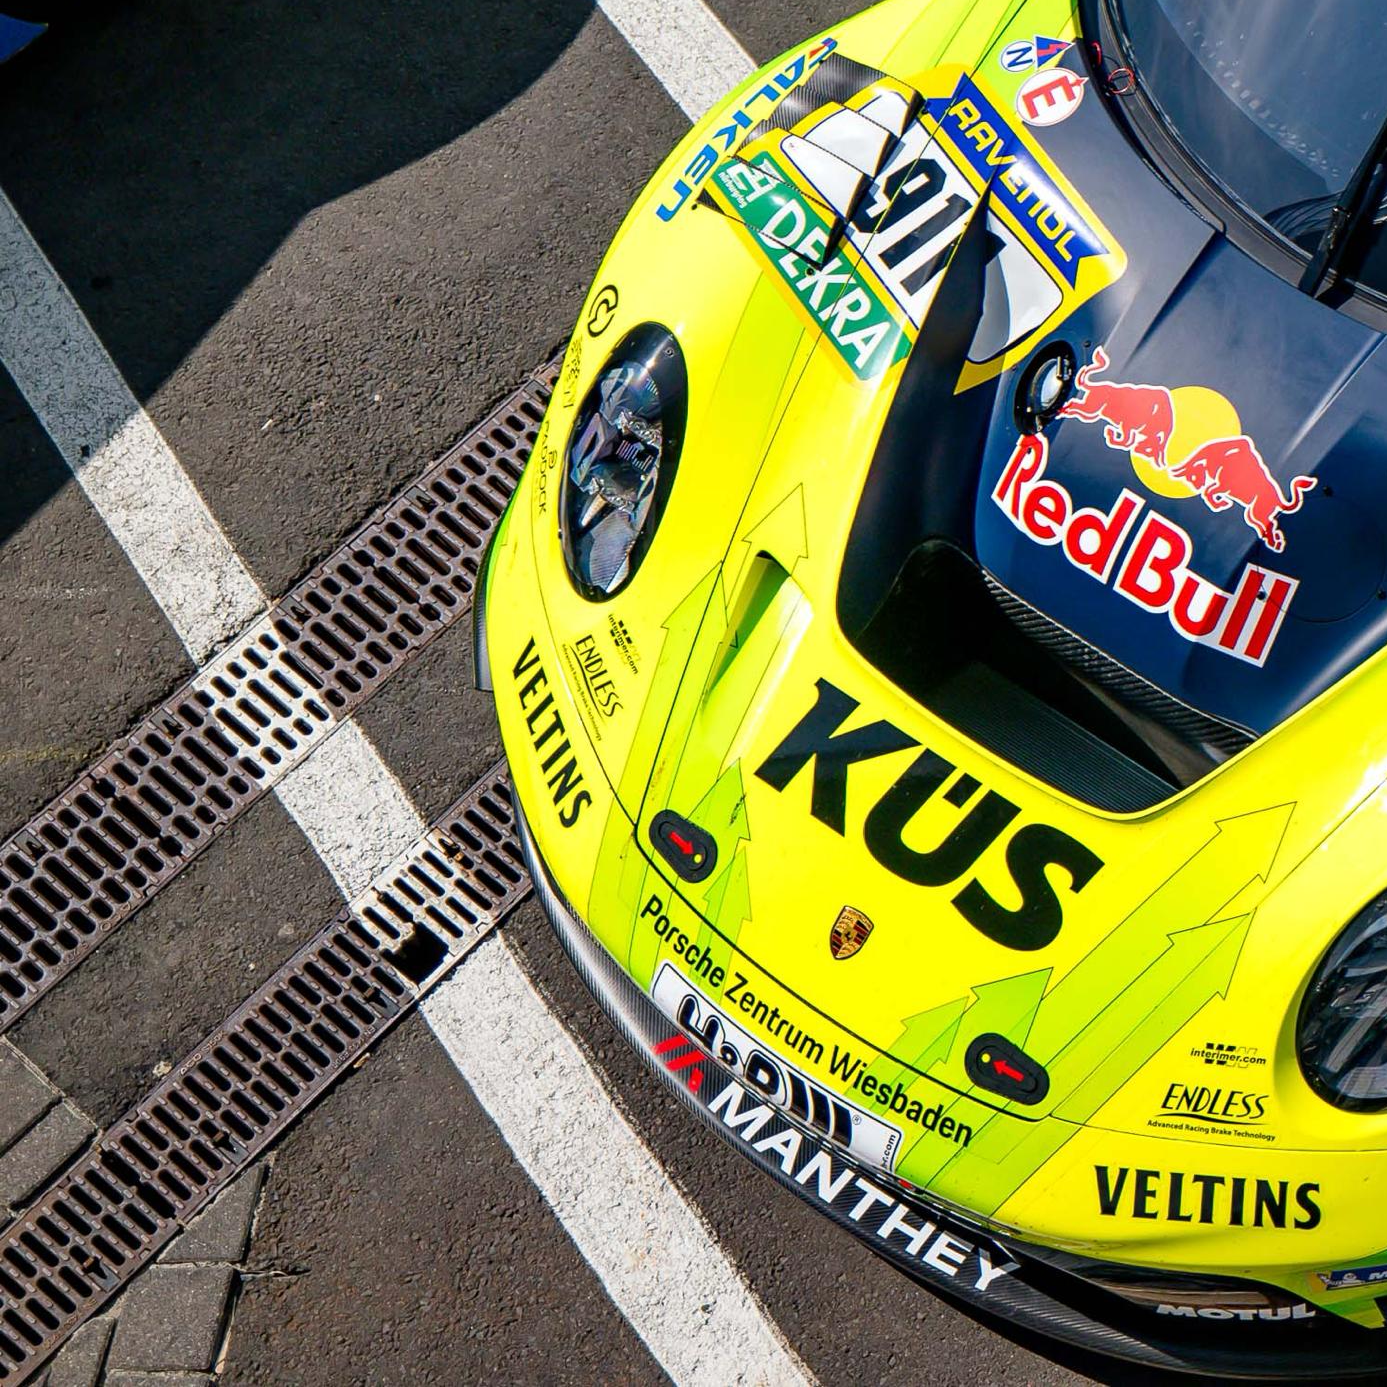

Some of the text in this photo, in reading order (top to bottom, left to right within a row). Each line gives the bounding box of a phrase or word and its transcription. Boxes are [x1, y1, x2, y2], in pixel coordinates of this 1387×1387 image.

[1004, 46, 1033, 68] N
[1020, 78, 1076, 121] E
[655, 36, 839, 222] FALKEN
[948, 98, 1078, 263] RAVENOL
[758, 198, 892, 371] DEKRA
[991, 431, 1300, 668] Red Bull
[510, 635, 594, 829] VELTINS
[574, 633, 624, 718] ENDLESS
[753, 676, 1104, 952] KÜS
[640, 894, 973, 1148] Porsche Zentrum Wiesbaden
[1190, 1047, 1267, 1066] interimer.com
[1147, 1119, 1276, 1142] Advanced Racing Brake Technology
[1160, 1082, 1270, 1120] ENDLESS
[707, 1080, 1022, 1292] MANTHEY
[1094, 1164, 1323, 1231] VELTINS
[1155, 1302, 1317, 1322] MOTUL
